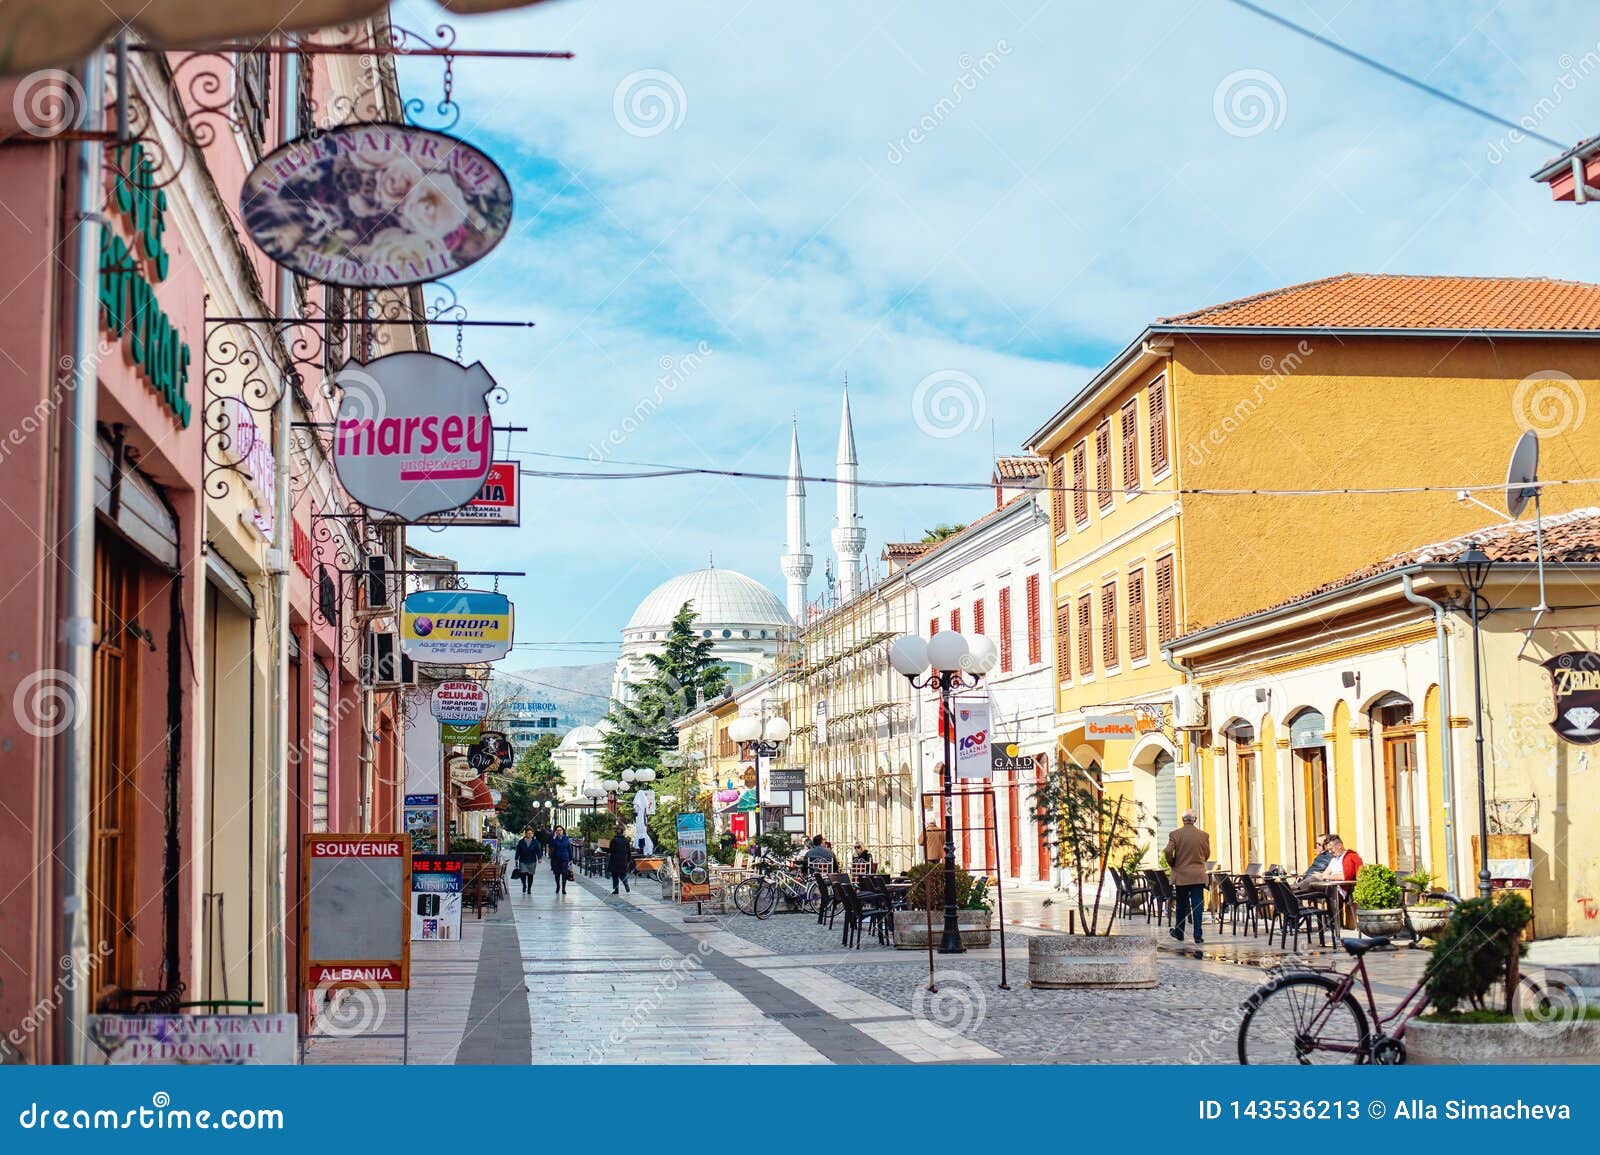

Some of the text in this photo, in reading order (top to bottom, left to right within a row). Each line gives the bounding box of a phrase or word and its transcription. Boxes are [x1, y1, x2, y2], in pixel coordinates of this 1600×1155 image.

[100, 221, 191, 430] ATYRALE
[337, 414, 491, 470] marsey
[401, 457, 473, 471] underwear
[436, 618, 499, 630] EUROPA
[450, 630, 484, 638] TRAVEL
[443, 683, 477, 692] SERVIS
[528, 702, 558, 711] EUROPA
[994, 757, 1032, 768] GALD
[315, 843, 400, 856] SOUVENIR
[319, 967, 393, 981] ALBANIA
